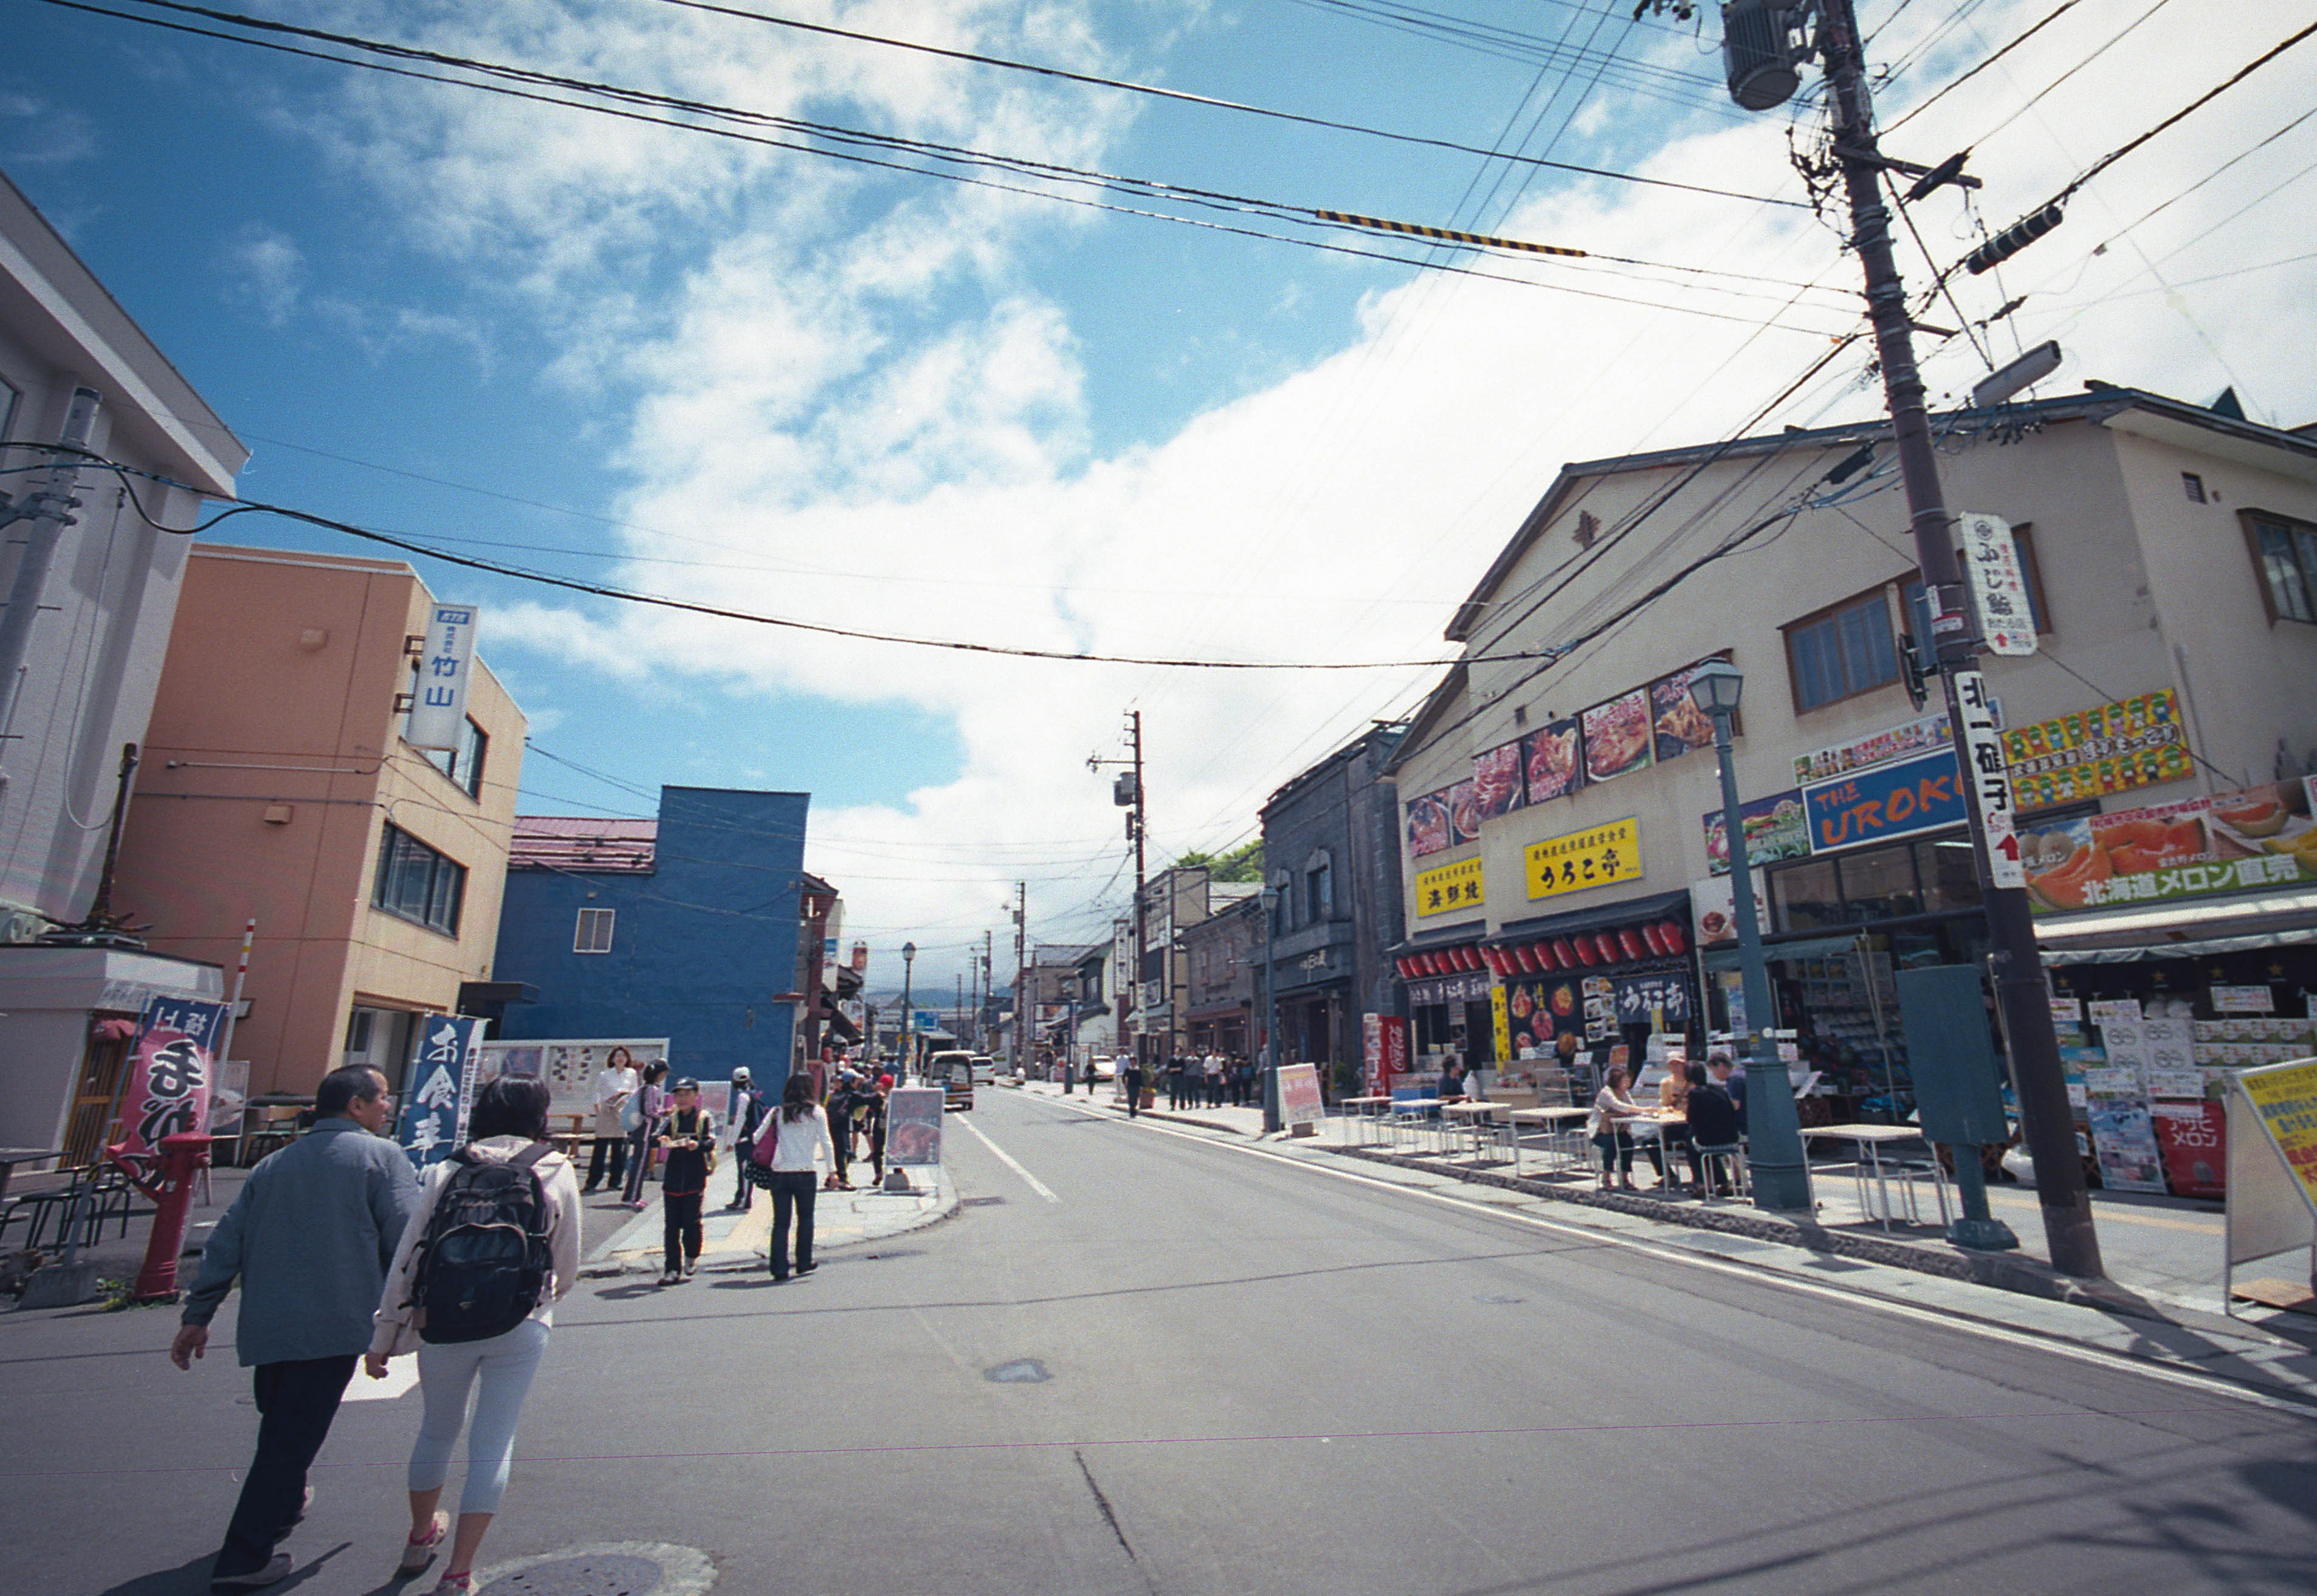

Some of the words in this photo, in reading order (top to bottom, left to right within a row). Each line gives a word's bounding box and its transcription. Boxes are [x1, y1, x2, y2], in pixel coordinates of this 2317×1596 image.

[425, 656, 460, 706] 竹山
[1815, 781, 1860, 811] THE
[1541, 848, 1620, 889] うろこ亭
[2081, 853, 2300, 906] 北海道メロン直売
[1624, 982, 1684, 1016] うろこ亭
[2172, 1130, 2218, 1147] メロン
